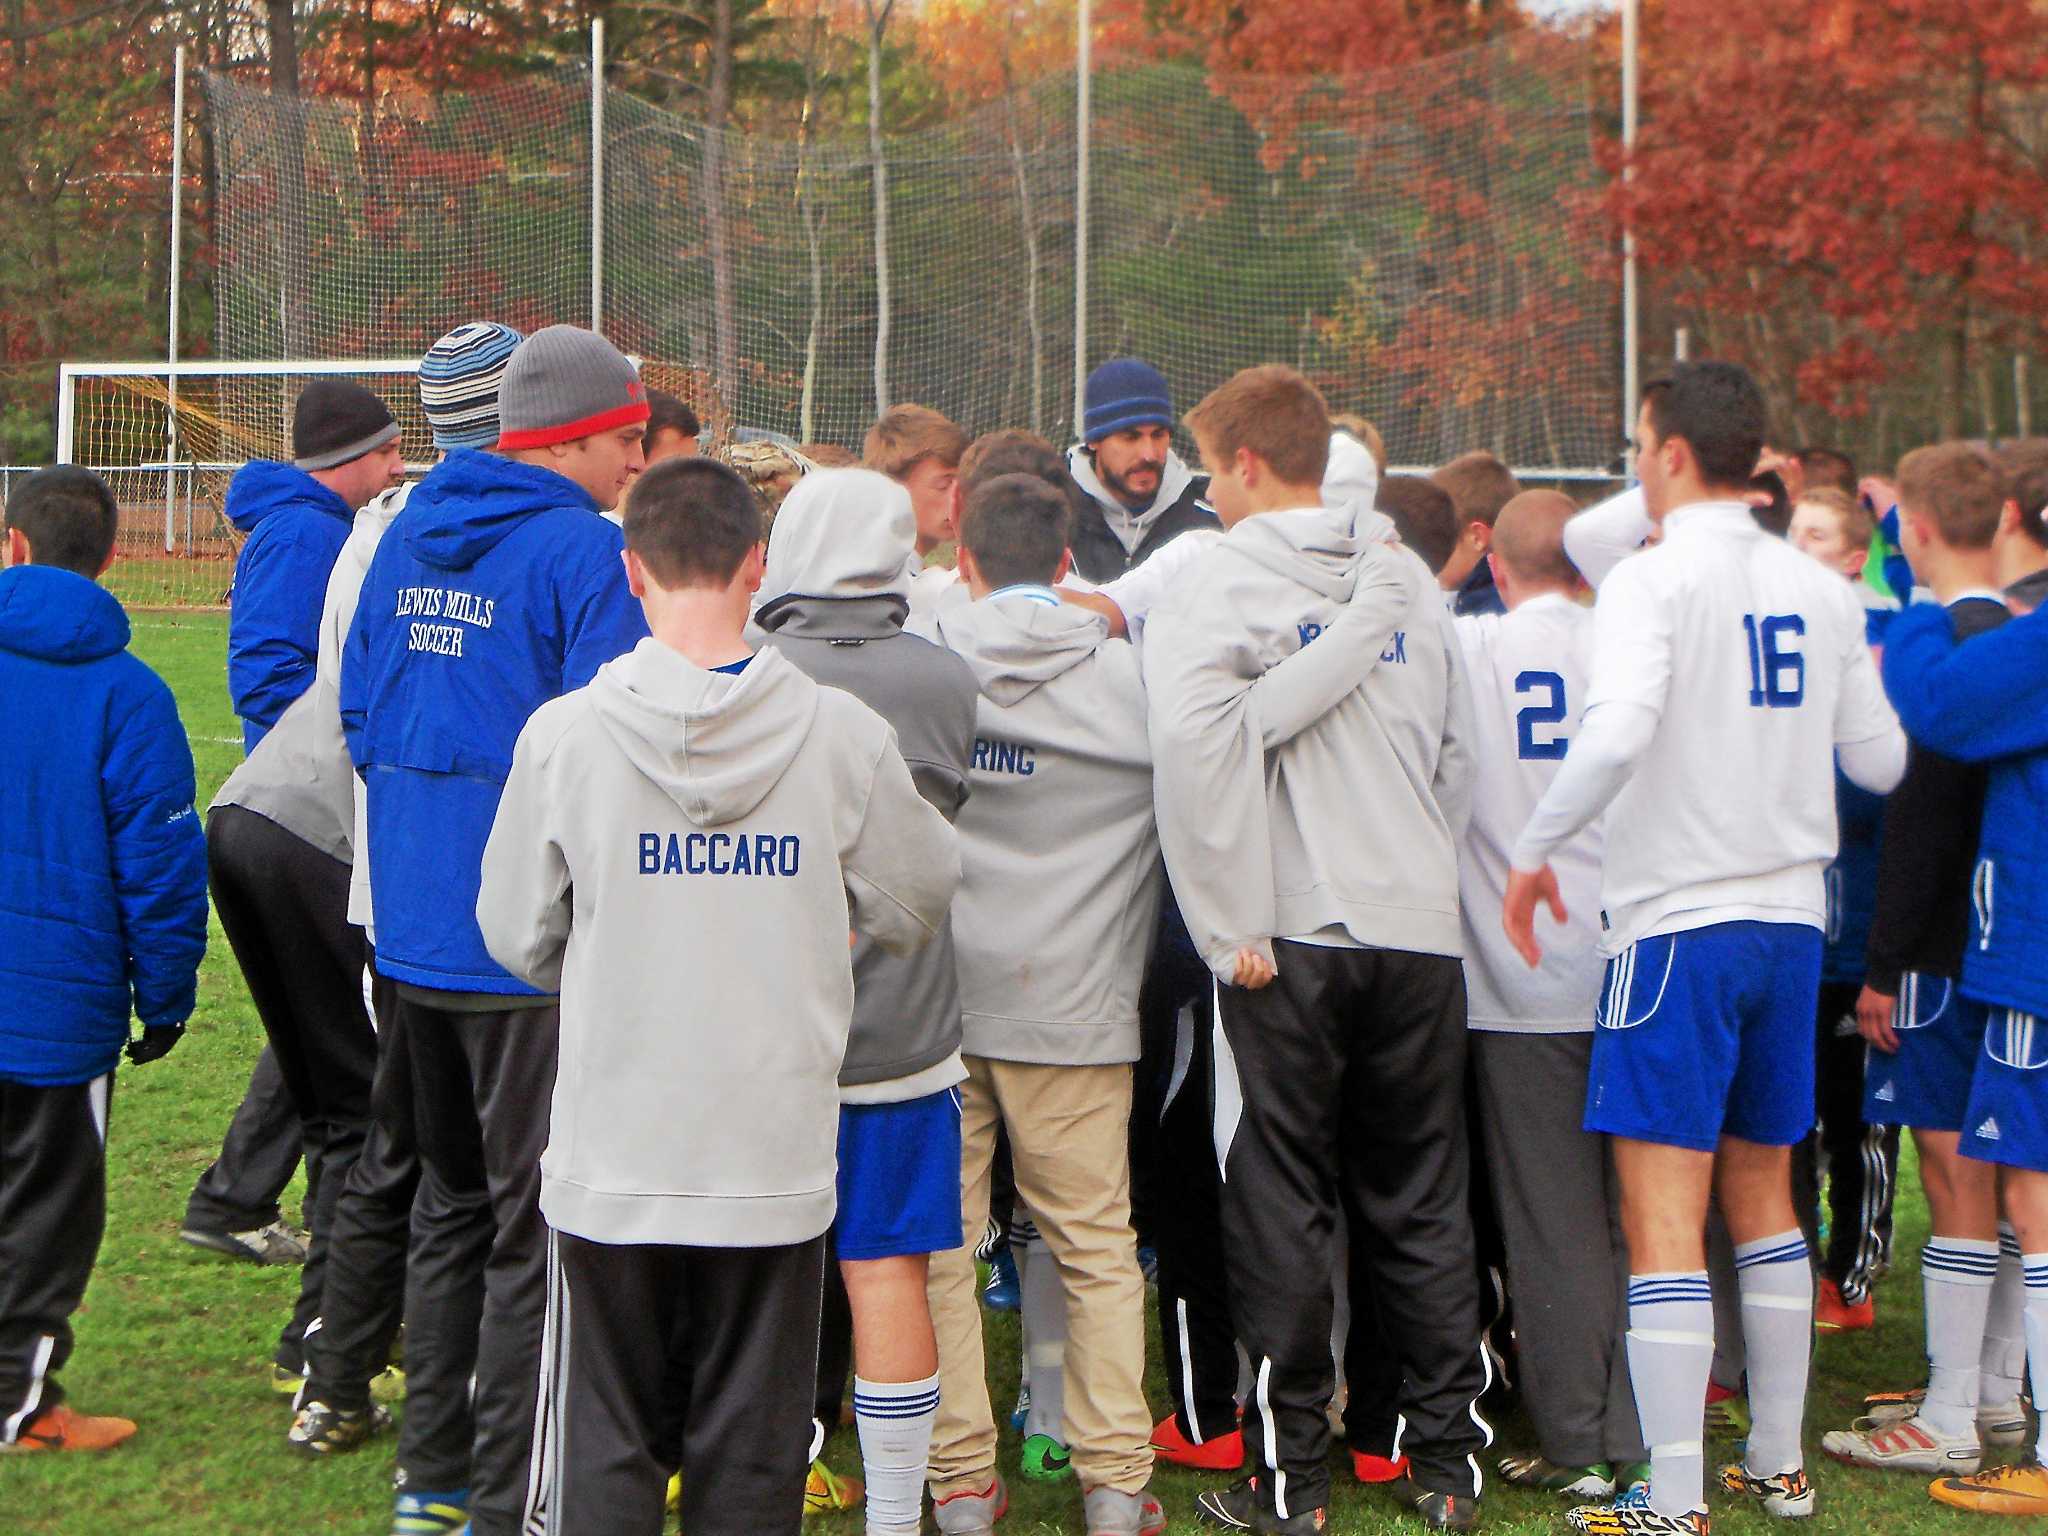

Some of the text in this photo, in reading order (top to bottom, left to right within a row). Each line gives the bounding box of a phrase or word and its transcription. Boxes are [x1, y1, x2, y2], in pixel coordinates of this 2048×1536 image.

[396, 587, 494, 629] LEWIS MILLS
[408, 622, 464, 658] SOCCER
[1744, 614, 1805, 708] 16
[1515, 670, 1568, 760] 2
[639, 833, 800, 877] BACCARO
